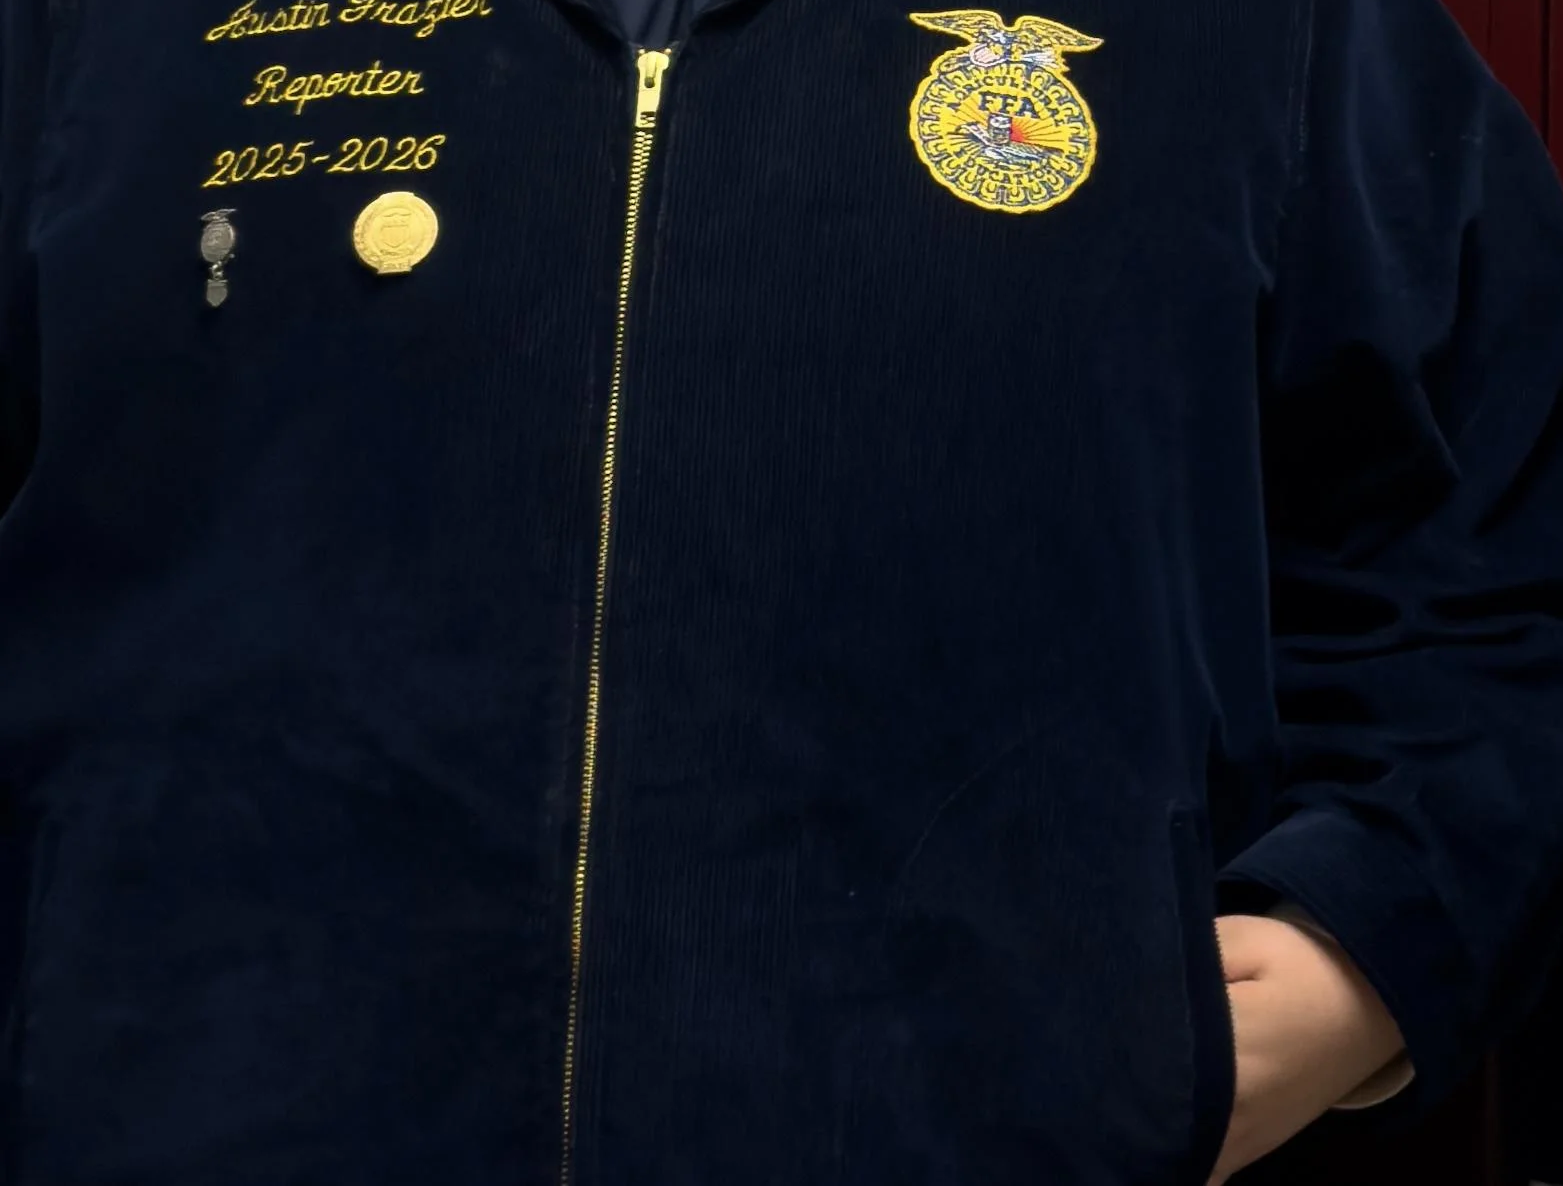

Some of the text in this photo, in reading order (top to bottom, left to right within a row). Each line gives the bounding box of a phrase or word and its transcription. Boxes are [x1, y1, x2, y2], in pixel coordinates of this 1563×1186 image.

[244, 59, 424, 115] Reporter
[978, 91, 1037, 119] FFA
[202, 134, 446, 188] 2025-2026
